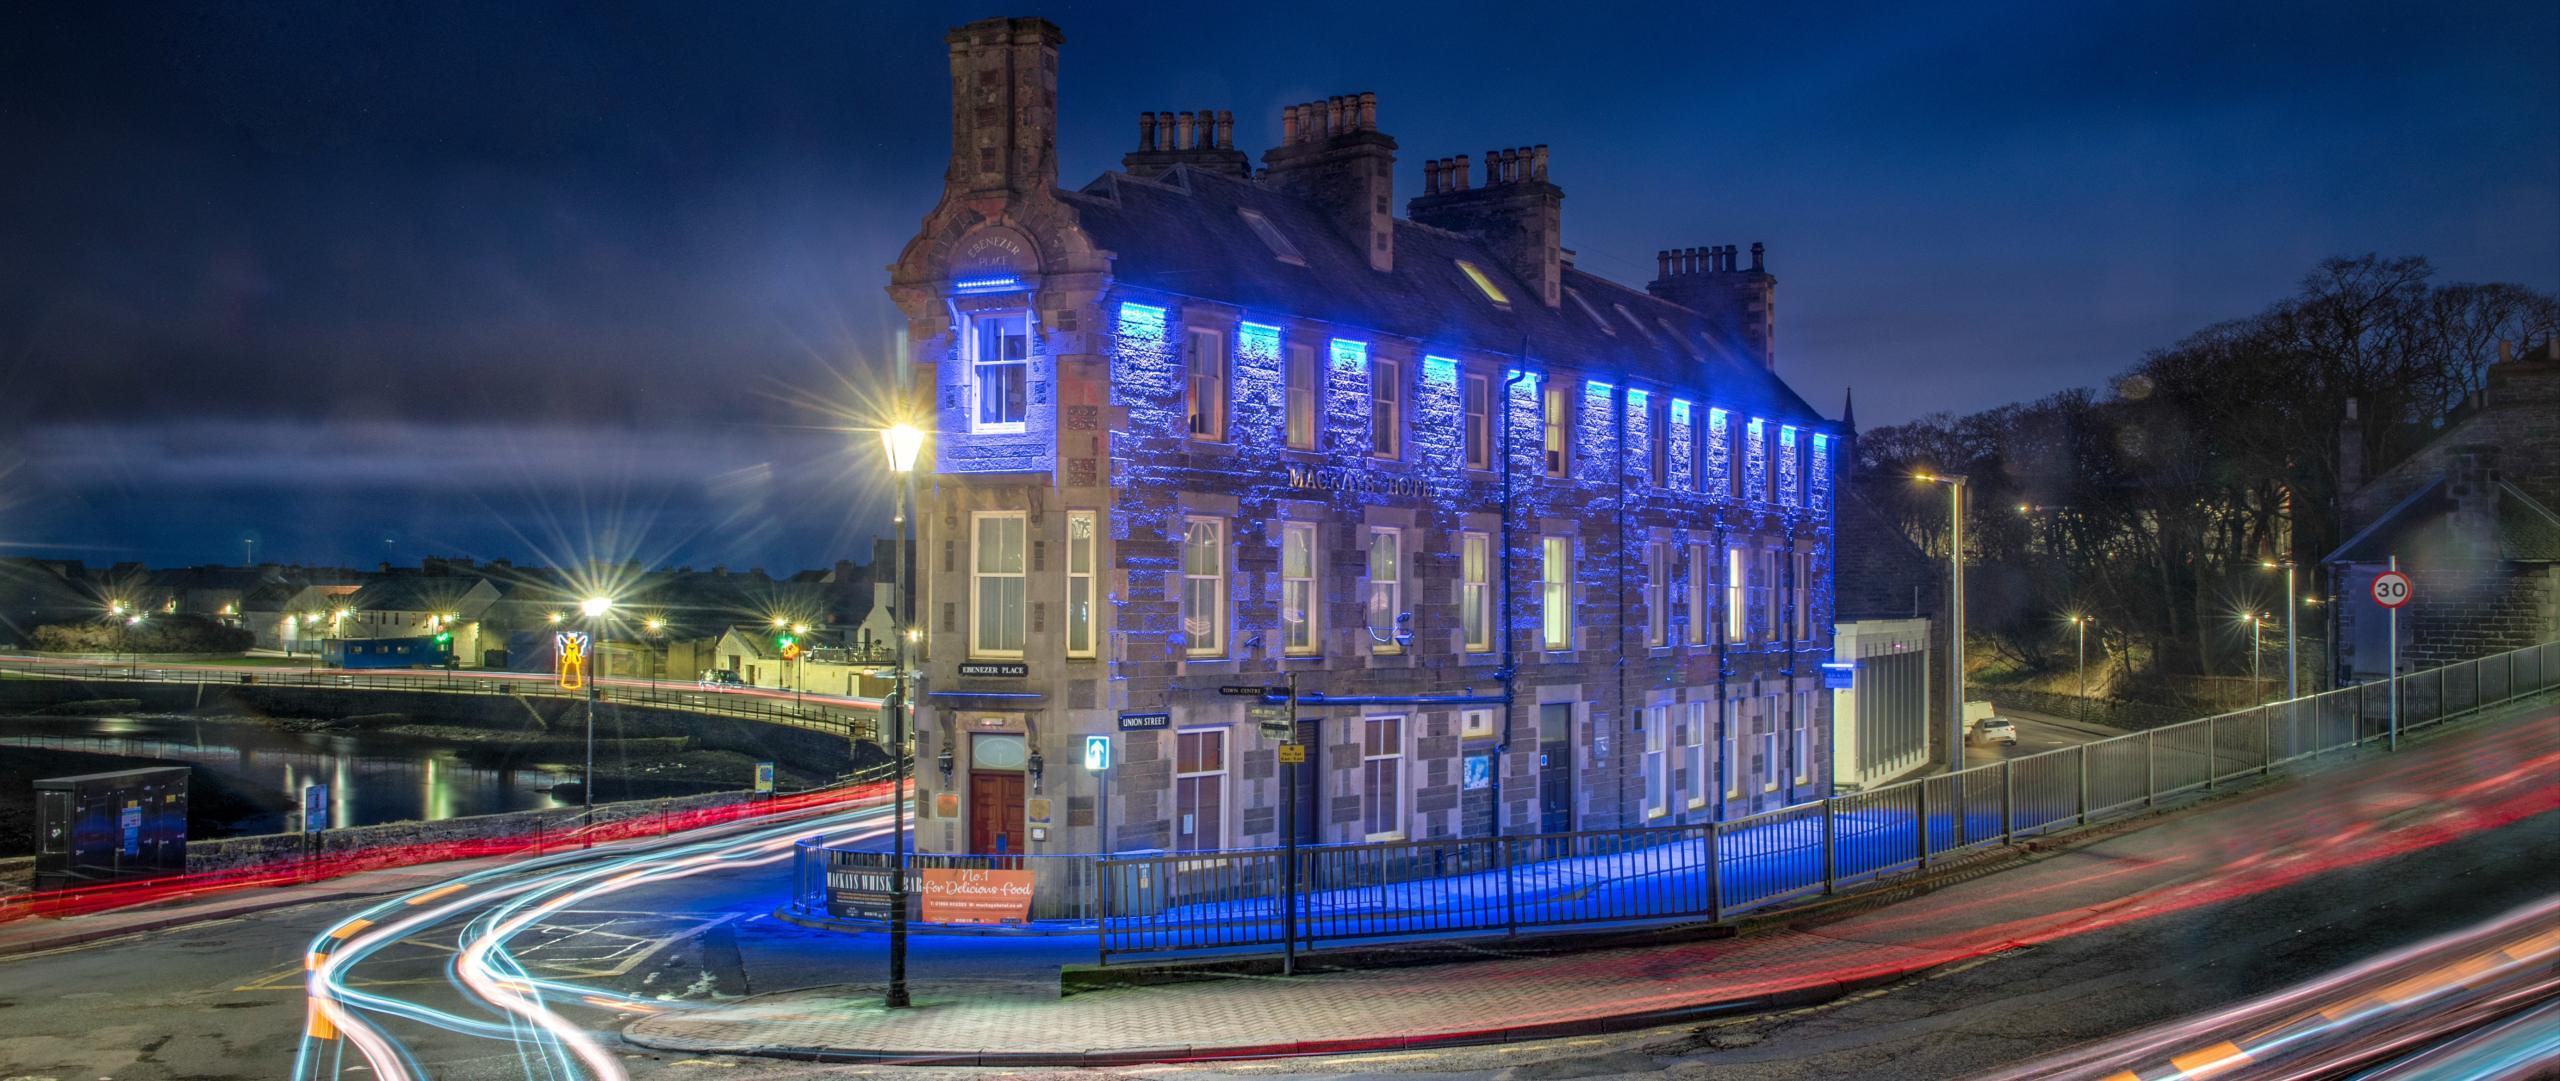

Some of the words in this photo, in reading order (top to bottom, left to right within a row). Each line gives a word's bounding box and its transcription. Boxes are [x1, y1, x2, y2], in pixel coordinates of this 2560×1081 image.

[967, 236, 1020, 258] EBENEZER
[2377, 582, 2406, 598] 30
[962, 666, 998, 674] EBENEZER
[1001, 666, 1024, 674] PLACE
[1123, 718, 1143, 727] UNION
[1144, 716, 1166, 726] STREET
[827, 871, 859, 891] MACKAYS
[862, 874, 893, 893] WHISK
[962, 868, 988, 882] No.1
[923, 880, 945, 895] for
[946, 880, 999, 895] Delicious
